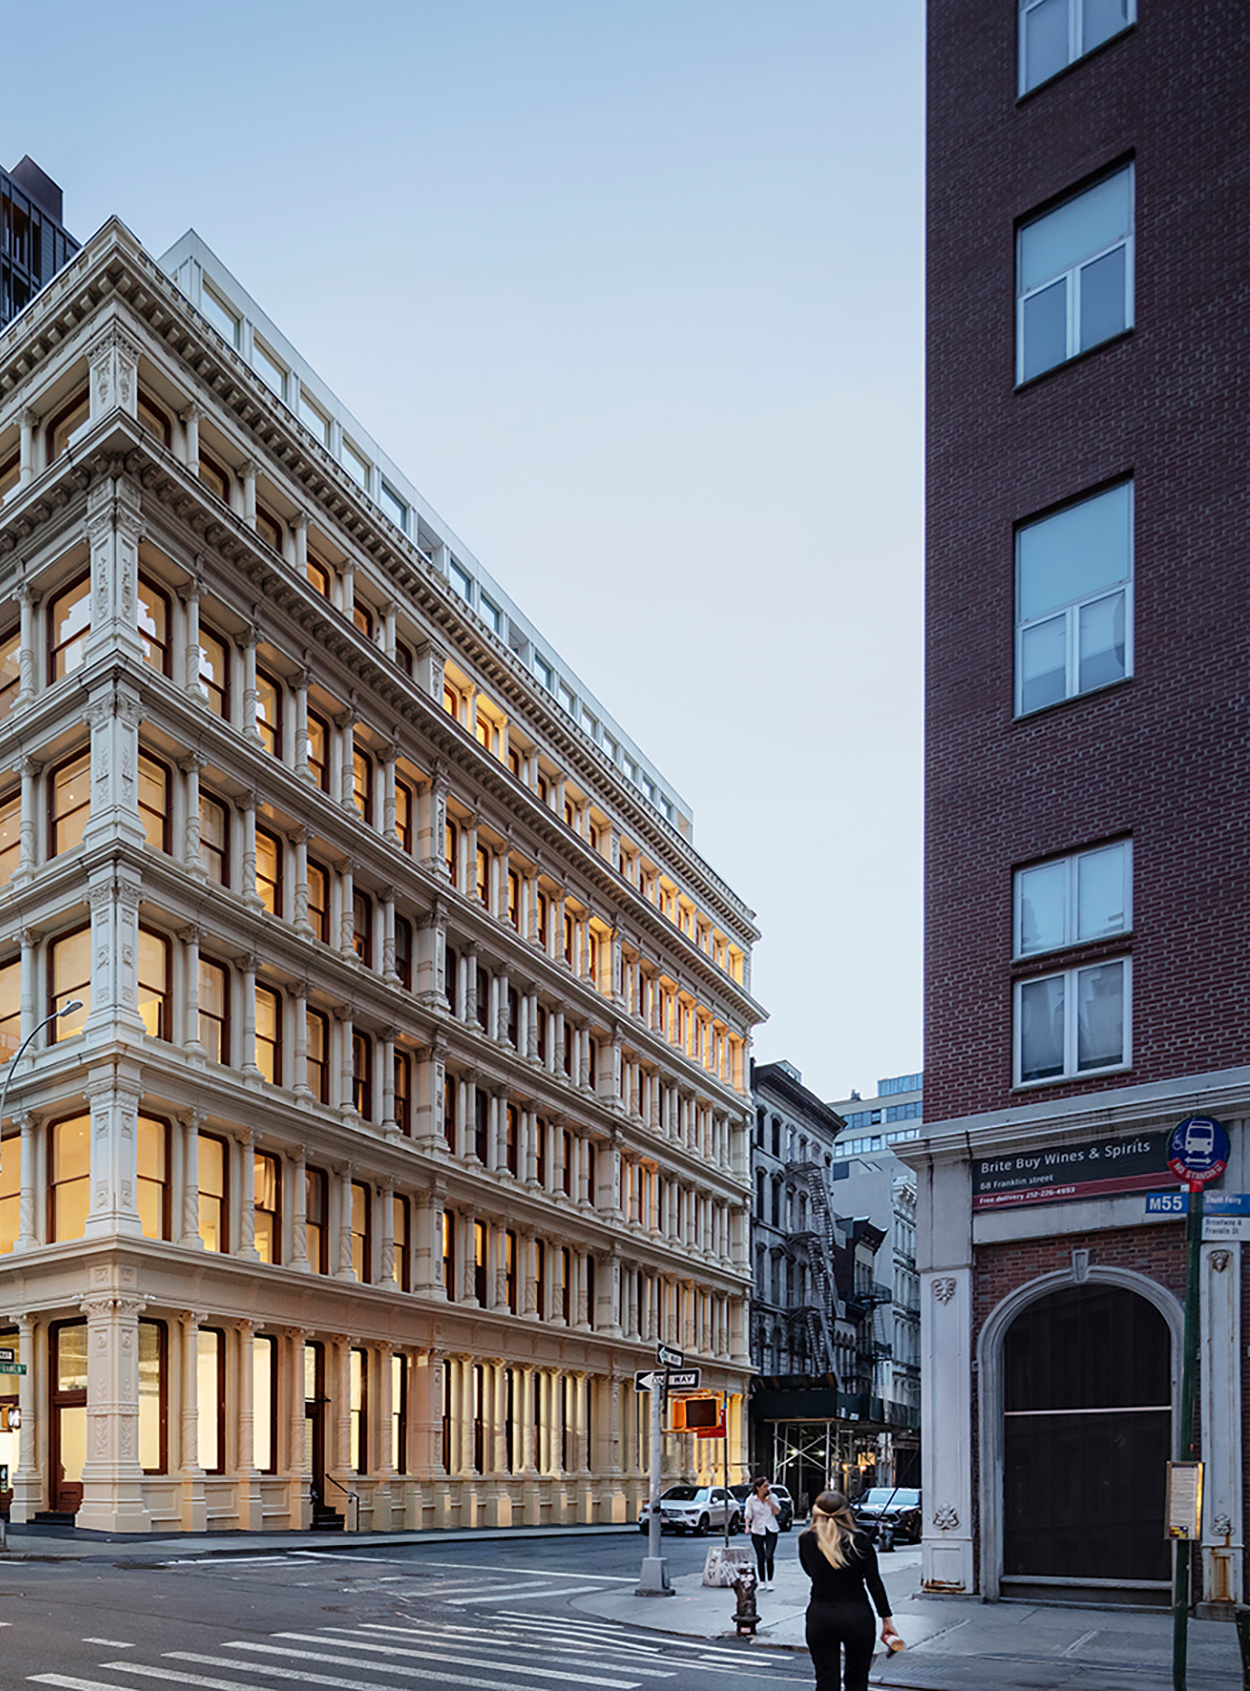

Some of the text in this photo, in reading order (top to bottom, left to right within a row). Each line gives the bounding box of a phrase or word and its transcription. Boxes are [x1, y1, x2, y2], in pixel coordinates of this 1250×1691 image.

[981, 1140, 1151, 1174] Brite Buy Wines & Spirits
[1173, 1162, 1185, 1174] NO
[980, 1174, 1054, 1190] 68 Franklin street
[996, 1193, 1025, 1203] delivery
[1149, 1196, 1183, 1211] M55
[1206, 1219, 1236, 1227] Broadway
[674, 1375, 693, 1384] WAY
